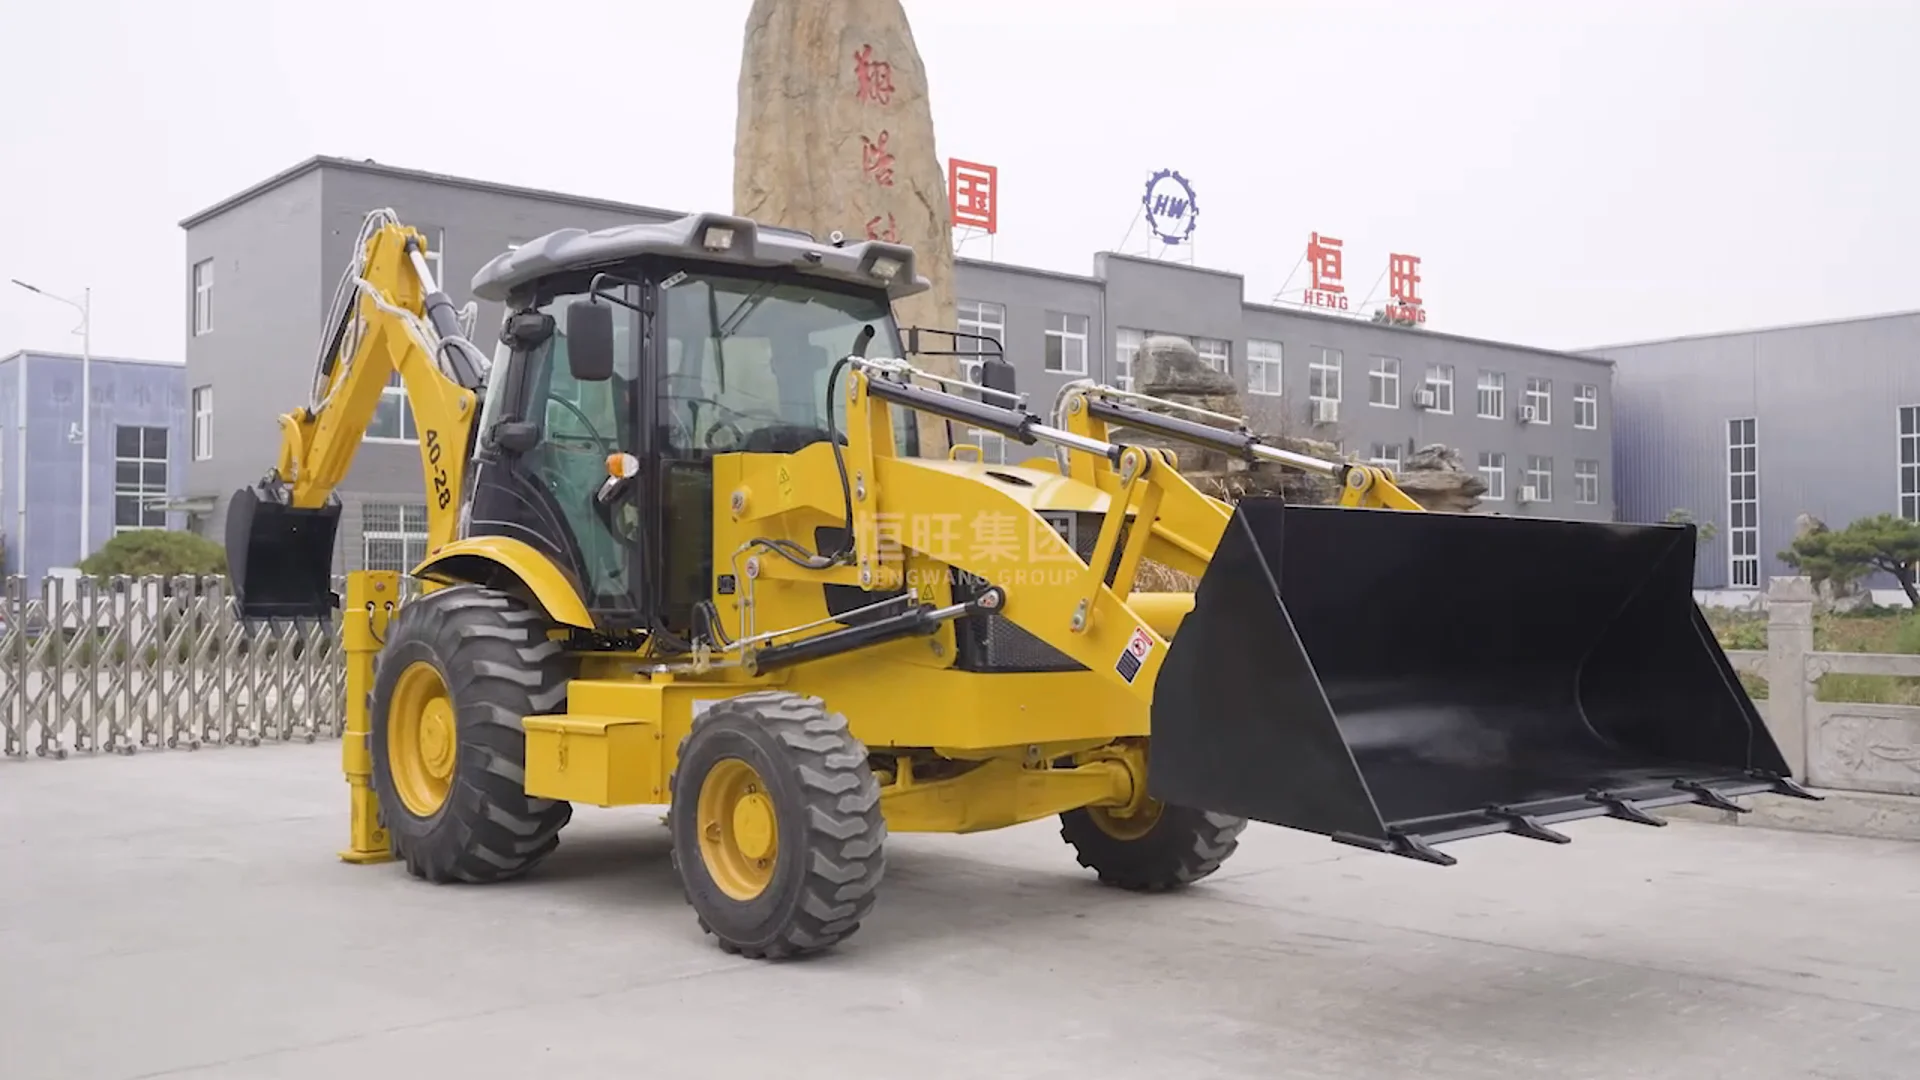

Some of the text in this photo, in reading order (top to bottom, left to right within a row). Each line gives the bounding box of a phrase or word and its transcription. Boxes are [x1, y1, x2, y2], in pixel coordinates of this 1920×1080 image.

[948, 157, 997, 234] 国
[1153, 194, 1189, 219] HW
[1304, 288, 1427, 323] HENG WANG
[426, 429, 452, 510] 40-28
